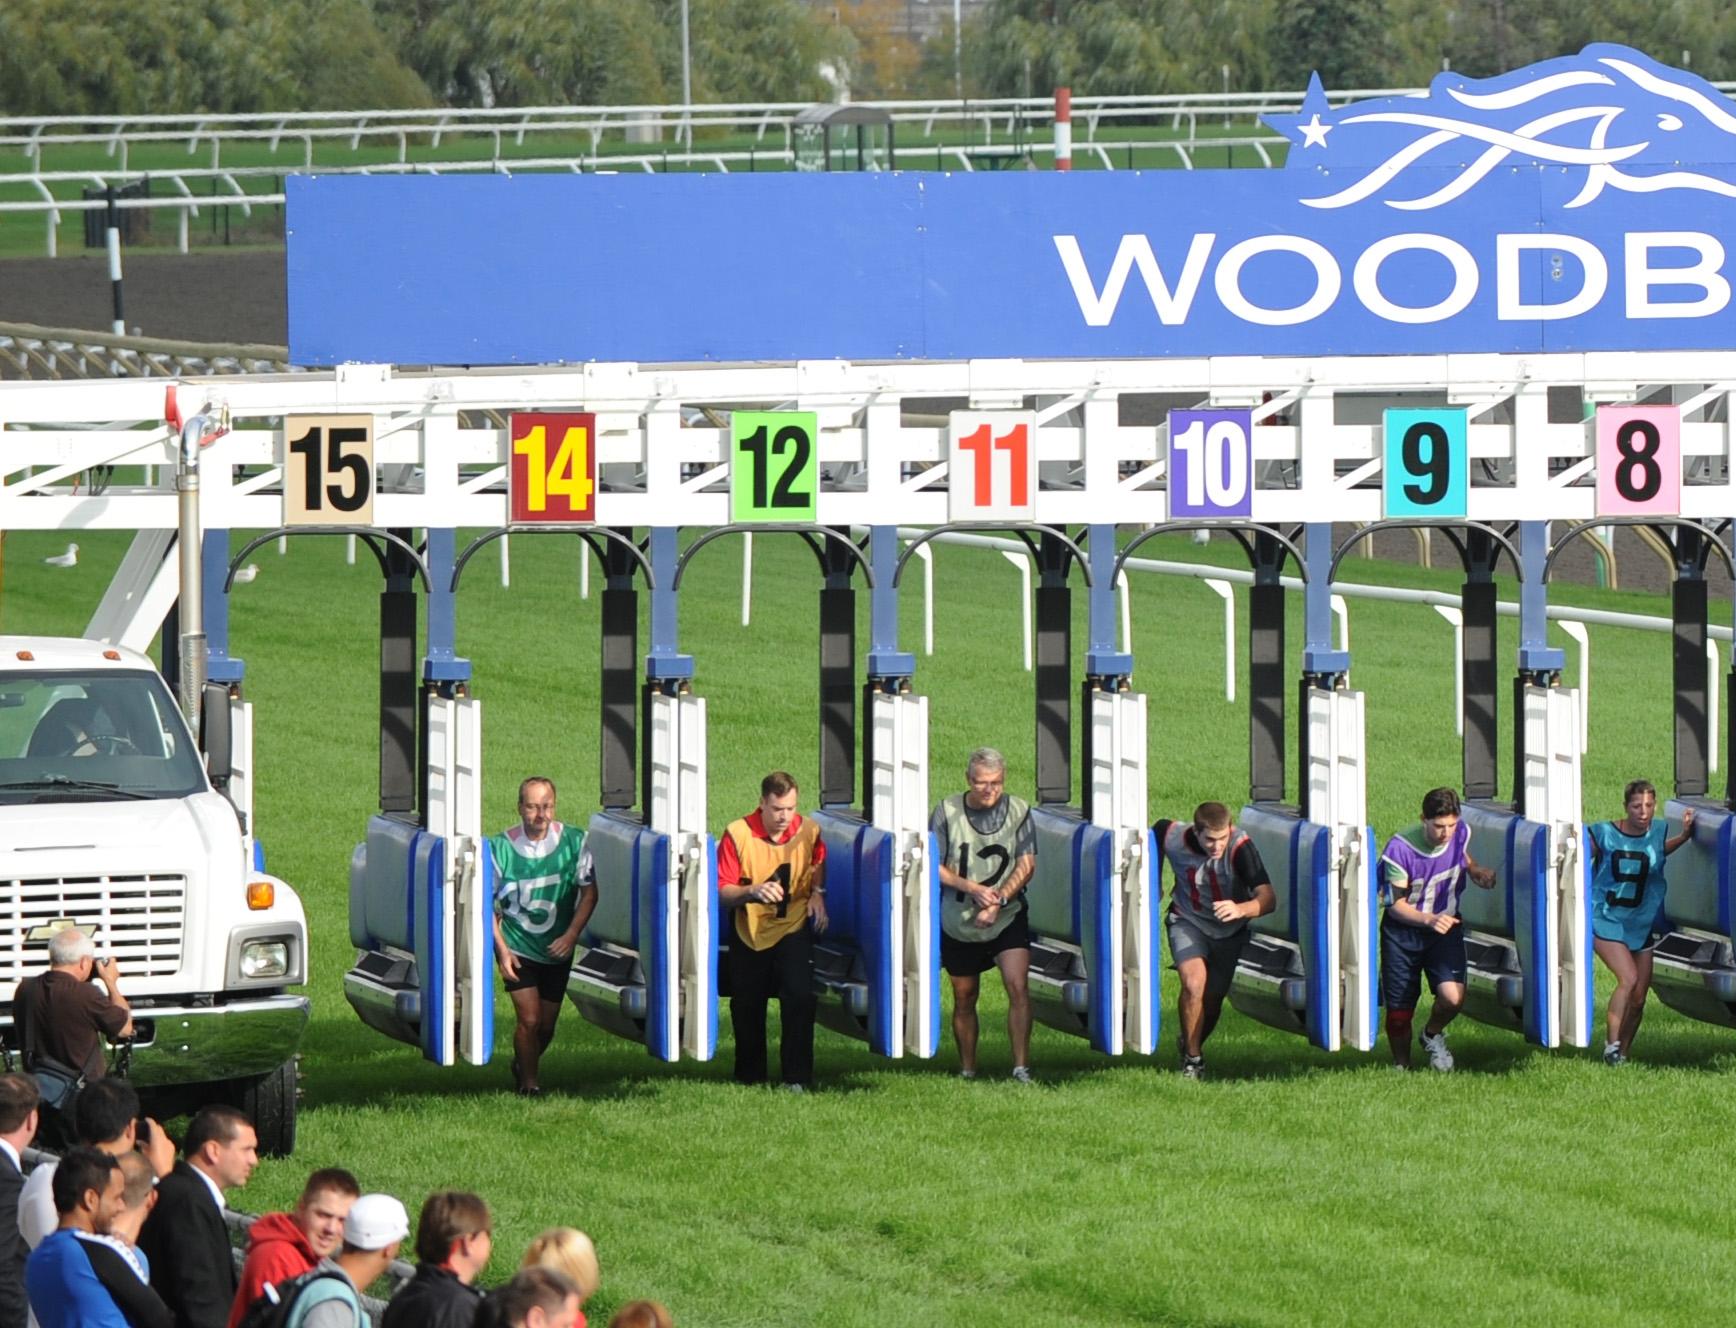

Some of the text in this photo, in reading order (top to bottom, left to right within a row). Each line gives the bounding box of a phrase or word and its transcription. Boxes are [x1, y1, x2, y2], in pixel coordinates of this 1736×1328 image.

[290, 427, 370, 512] 15
[513, 425, 593, 512] 14
[740, 425, 811, 508] 12
[958, 424, 1028, 507] 11
[1173, 420, 1248, 508] 10
[1402, 422, 1449, 505] 9
[1615, 419, 1661, 502] 8
[956, 841, 1010, 903] 12
[1605, 849, 1651, 908] 9
